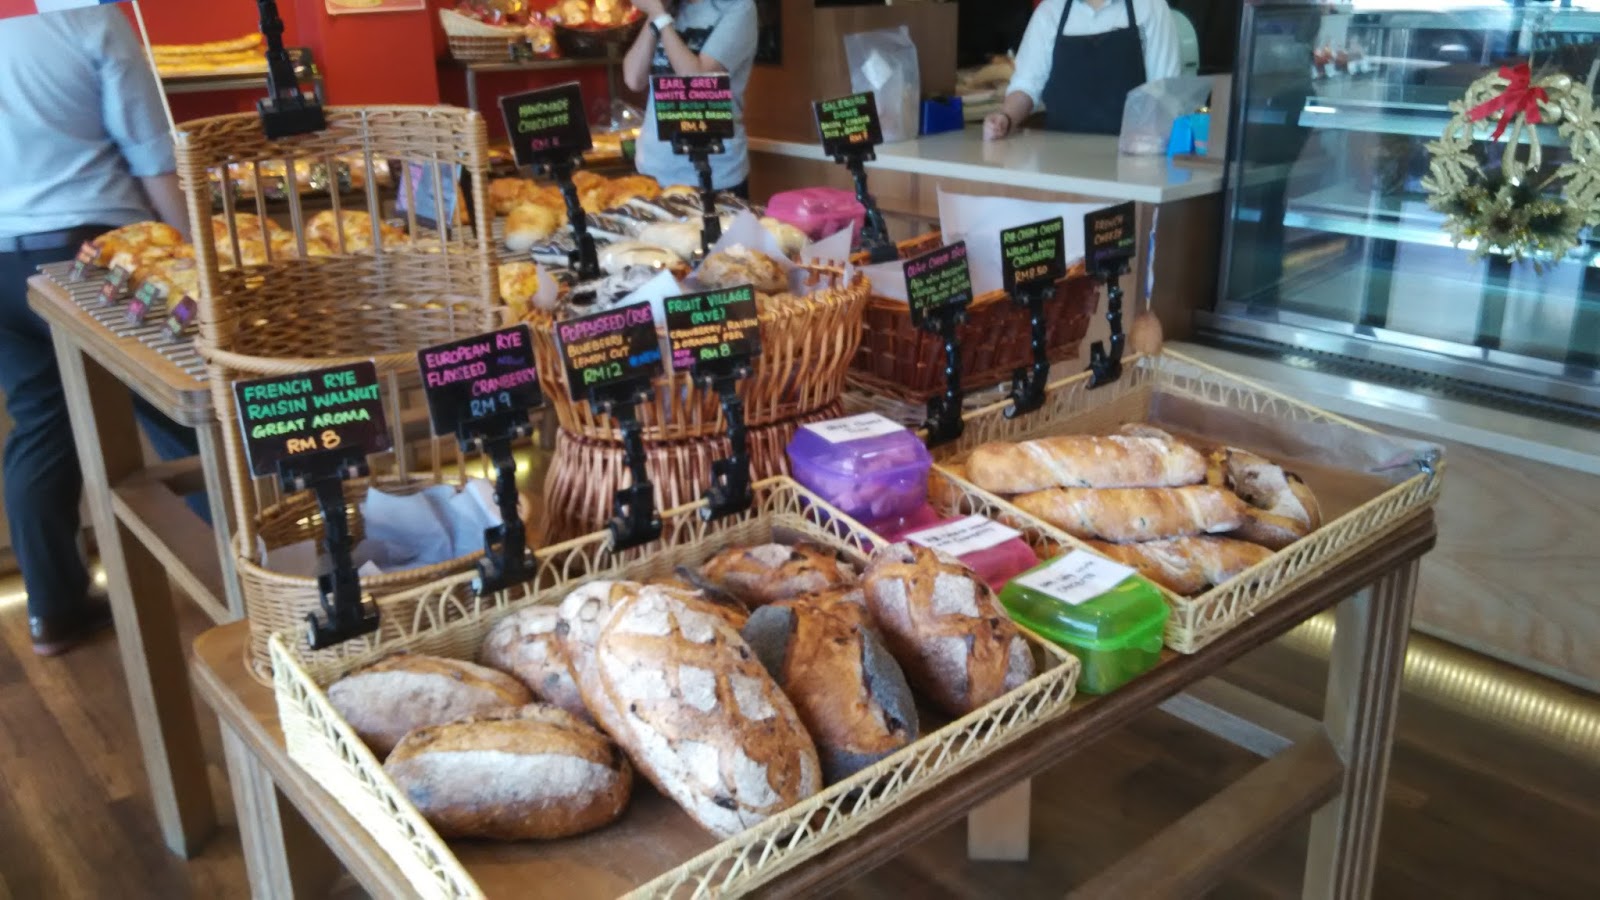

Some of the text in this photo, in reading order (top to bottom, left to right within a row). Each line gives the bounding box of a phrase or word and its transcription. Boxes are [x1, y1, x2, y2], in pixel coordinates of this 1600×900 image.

[654, 89, 733, 100] WHITE CHOCOLATE
[659, 77, 718, 89] EARL GREY
[667, 288, 750, 314] FRUIT VILLAGE
[691, 307, 726, 325] (RYE)
[727, 318, 758, 331] RAISIN
[425, 342, 491, 368] EUROPEAN
[495, 331, 522, 350] RYE
[700, 348, 719, 360] RM
[720, 343, 730, 357] 8
[243, 370, 357, 402] FRENCH RYE
[427, 361, 487, 388] FLAXSEED
[471, 367, 536, 396] CRANBERRY
[247, 384, 380, 420] RAISIN WALNUT
[470, 391, 512, 417] RM 9
[251, 408, 371, 439] GREAT AROMA
[286, 429, 341, 454] RM 8
